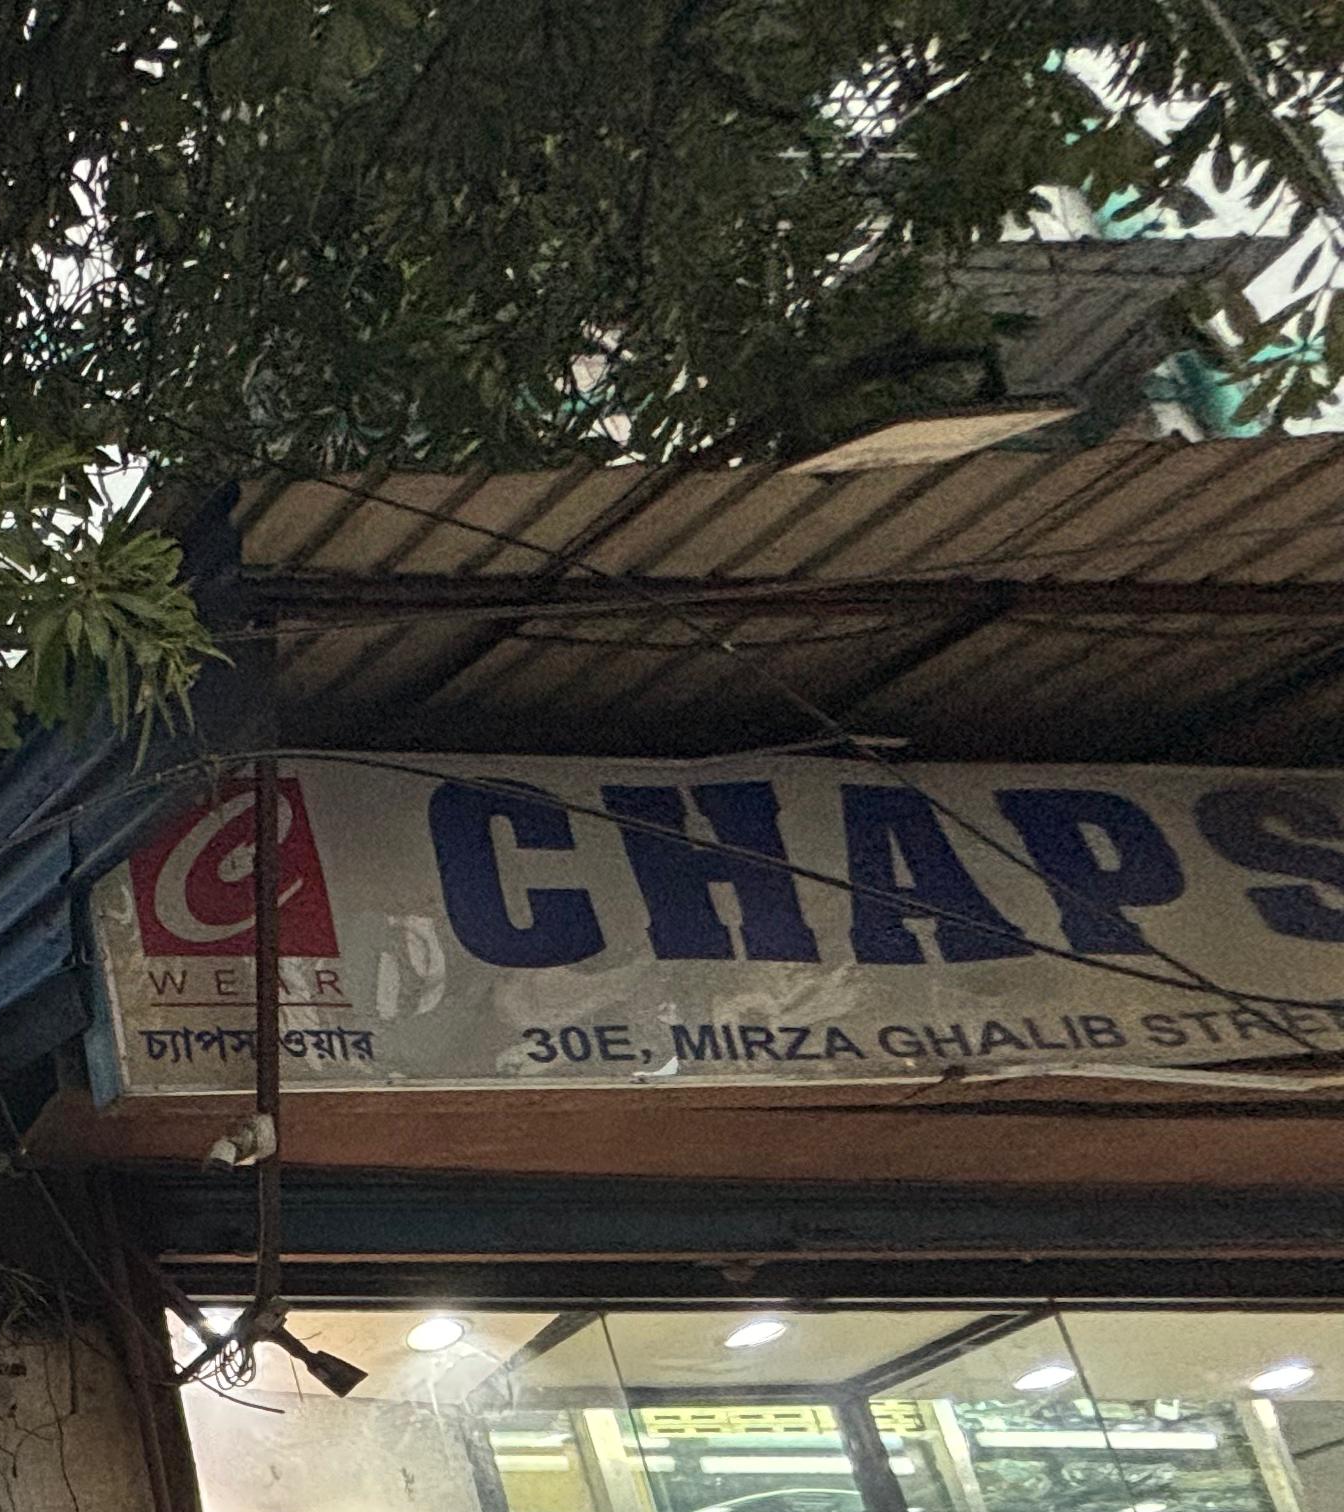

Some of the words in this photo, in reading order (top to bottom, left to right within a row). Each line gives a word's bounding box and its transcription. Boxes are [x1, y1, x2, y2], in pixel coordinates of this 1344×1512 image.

[428, 776, 1344, 968] CHAPS
[148, 968, 342, 996] WER
[522, 1023, 653, 1066] 30E,
[674, 1022, 867, 1063] MIRZA
[878, 1012, 1128, 1059] GHALIB
[1140, 1003, 1344, 1049] STRE
